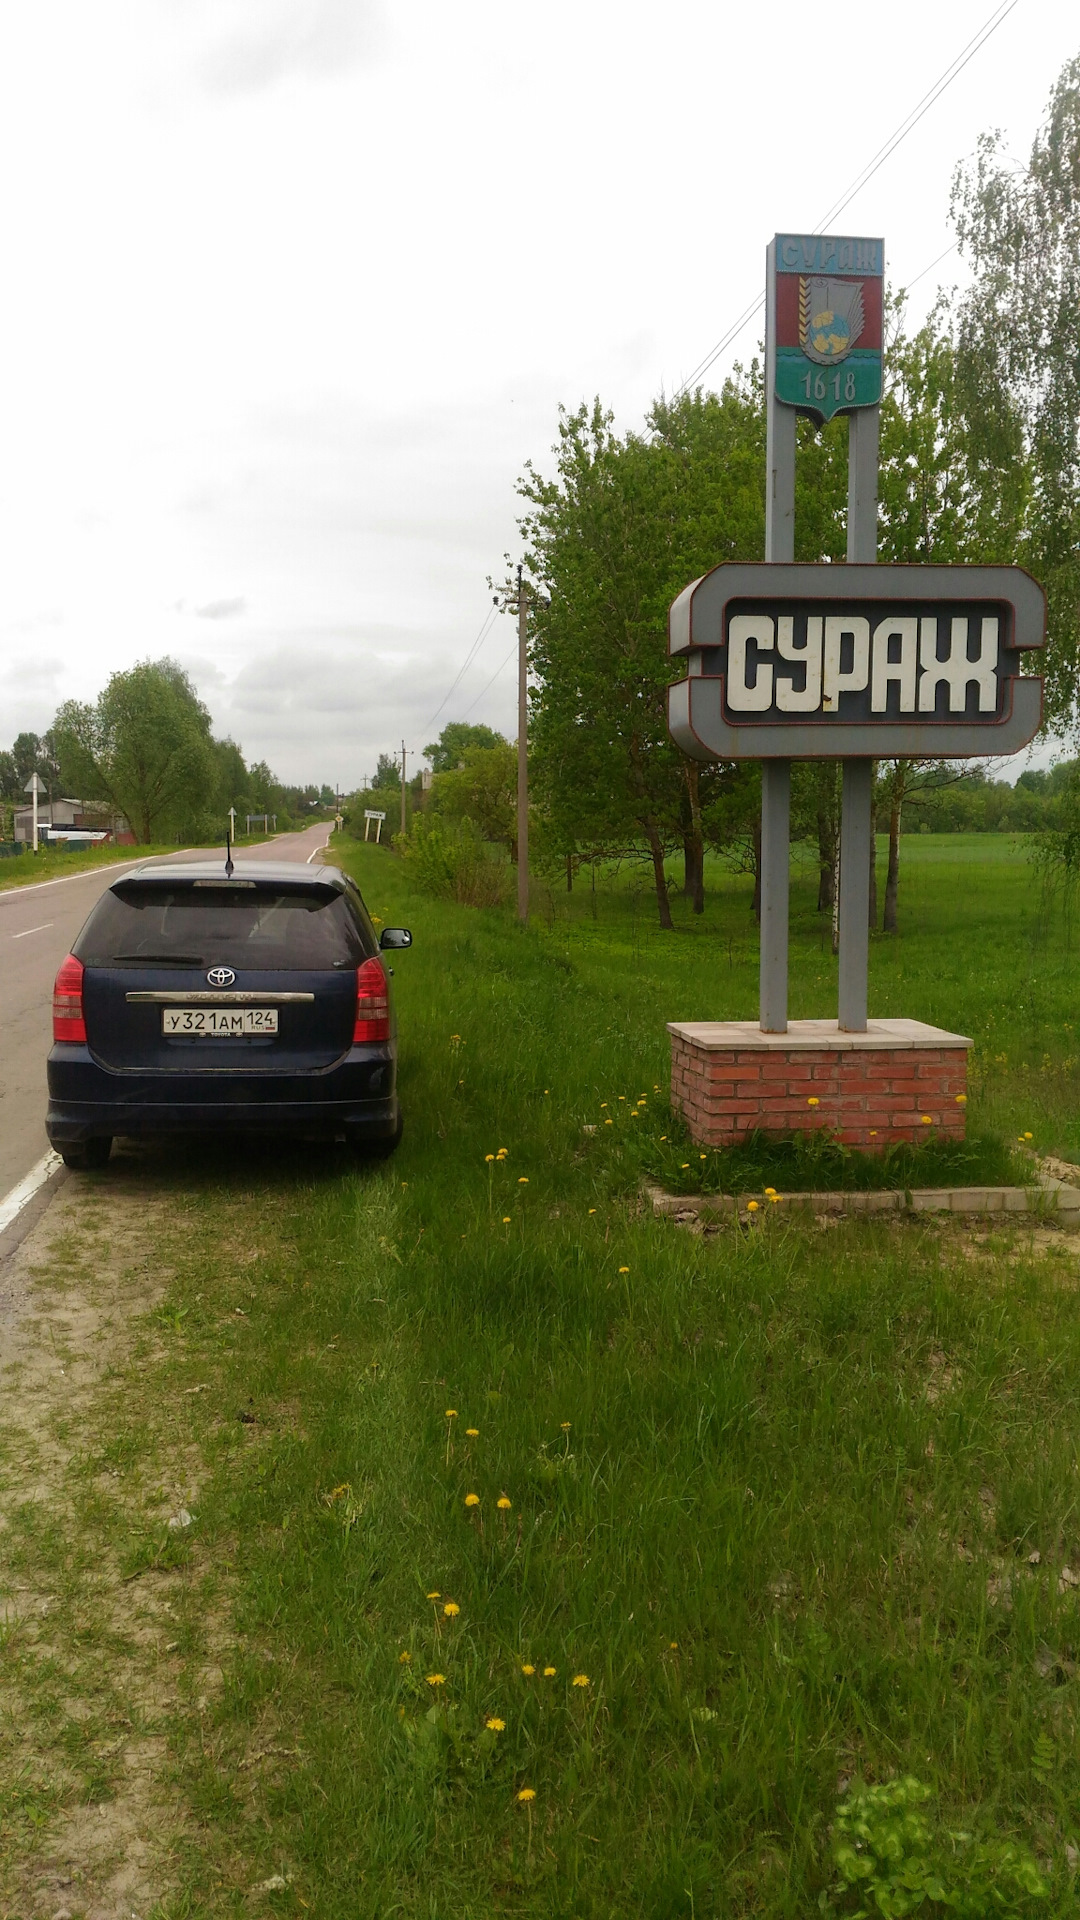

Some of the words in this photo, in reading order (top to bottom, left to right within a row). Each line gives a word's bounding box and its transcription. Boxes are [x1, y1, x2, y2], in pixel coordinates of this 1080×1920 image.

[782, 240, 877, 271] СУРАЖ
[801, 370, 856, 402] 1618
[727, 615, 999, 712] СУРАЖ
[246, 1011, 273, 1025] 124
